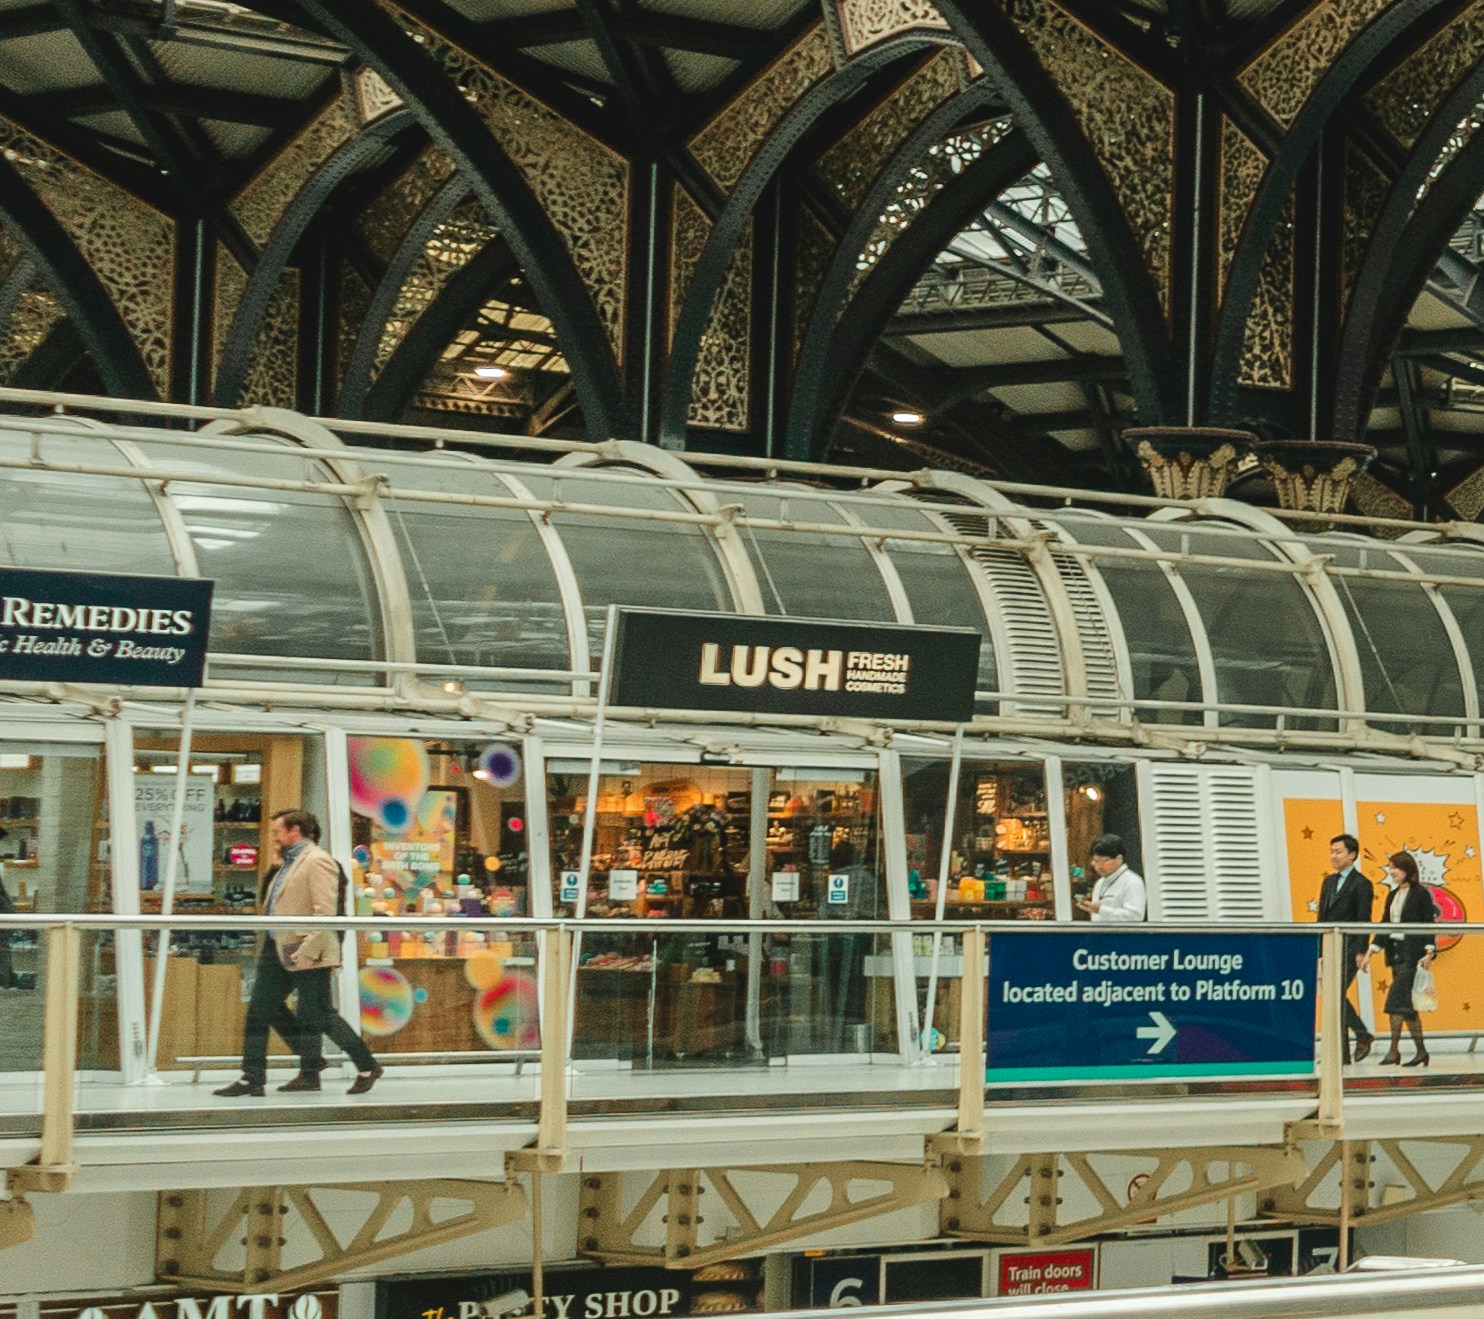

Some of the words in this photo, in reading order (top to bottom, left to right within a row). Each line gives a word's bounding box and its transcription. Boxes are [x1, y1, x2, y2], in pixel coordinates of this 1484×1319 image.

[1, 596, 194, 636] REMEDIES
[13, 634, 82, 657] Health
[86, 637, 113, 658] &
[114, 639, 187, 665] Beauty
[846, 651, 910, 672] FRESH
[698, 642, 844, 692] LUSH
[846, 670, 908, 683] HANDMADE
[845, 681, 906, 694] COSMETICS
[1072, 948, 1169, 971] Customer
[1173, 948, 1243, 974] Lounge
[1002, 981, 1078, 1003] located
[1082, 980, 1166, 1006] adjacent
[1169, 982, 1191, 1001] to
[1195, 979, 1276, 1001] Platform
[1281, 980, 1305, 1001] 10
[1008, 1265, 1042, 1283] Train
[1045, 1263, 1083, 1279] doors
[1008, 1283, 1031, 1294] will
[584, 1288, 681, 1319] SHOP
